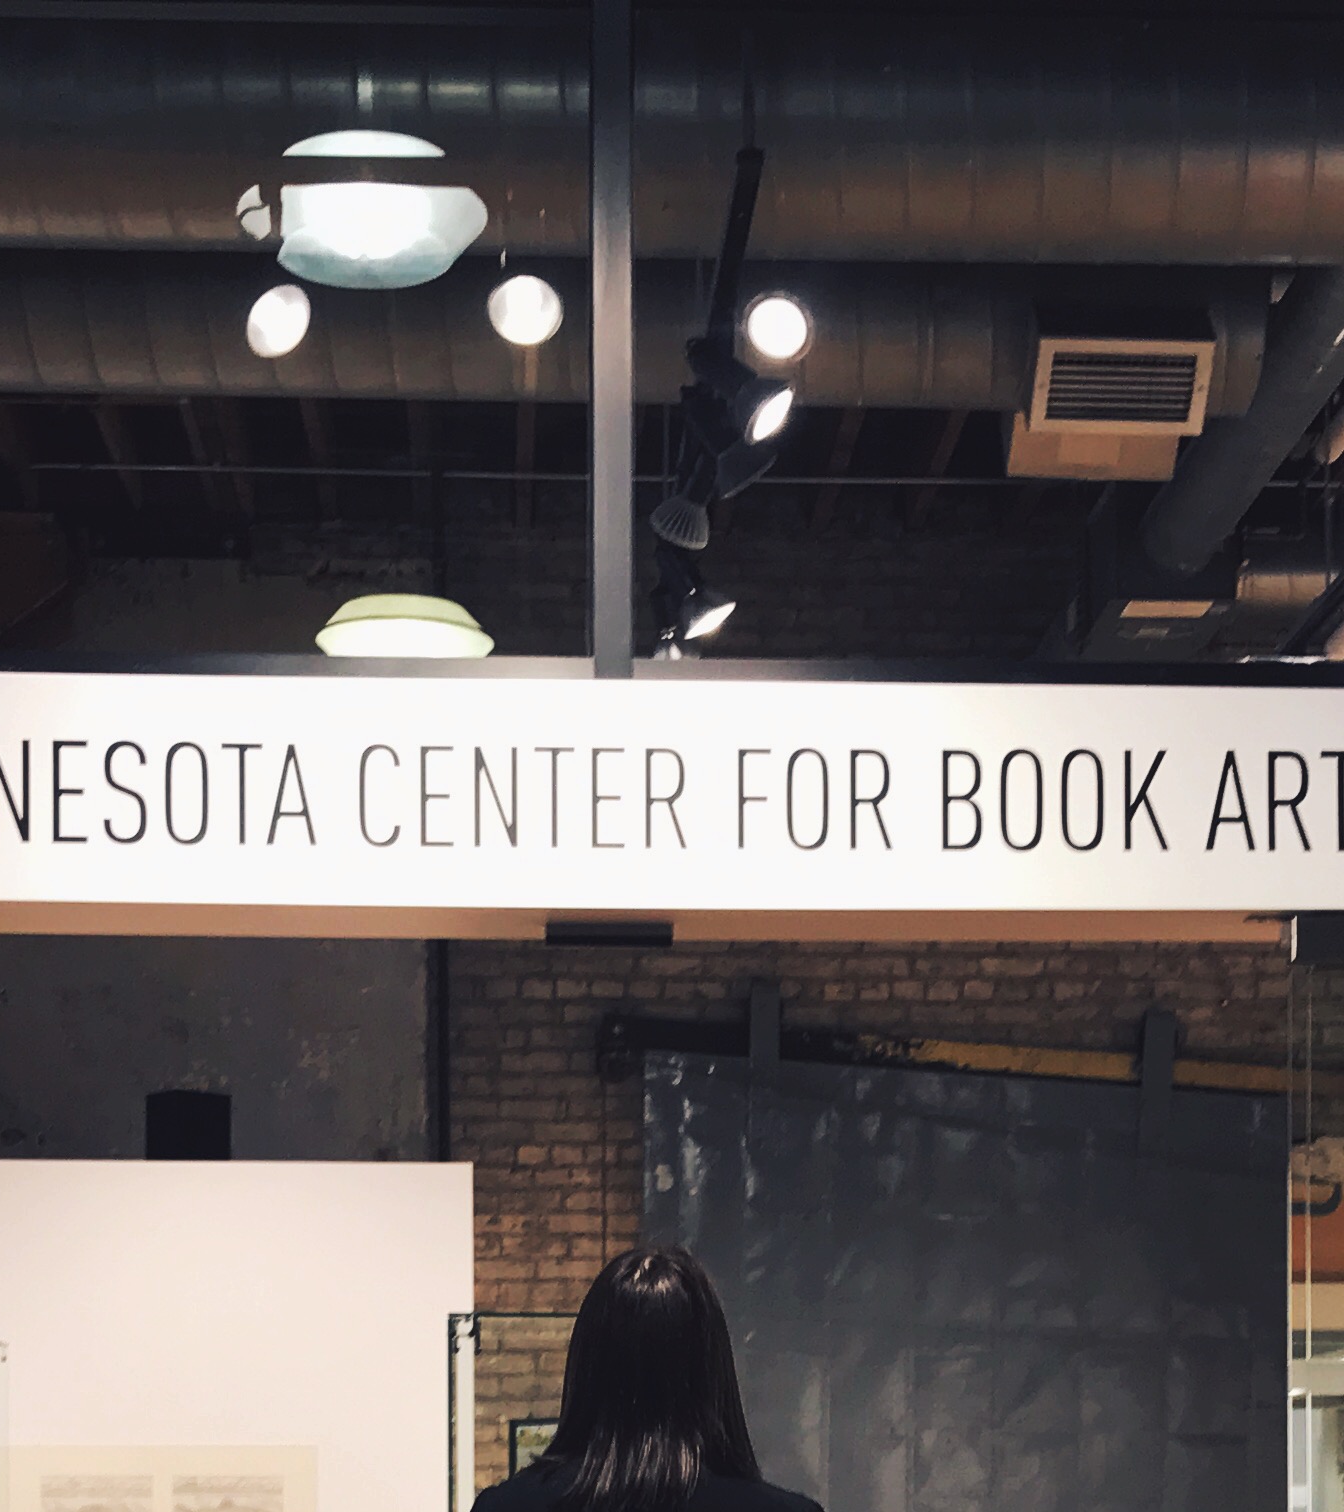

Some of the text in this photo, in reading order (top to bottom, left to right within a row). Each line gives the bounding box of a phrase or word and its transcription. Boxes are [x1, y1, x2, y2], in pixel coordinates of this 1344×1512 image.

[358, 743, 688, 850] CENTER
[737, 747, 894, 851] FOR
[940, 747, 1170, 853] BOOK
